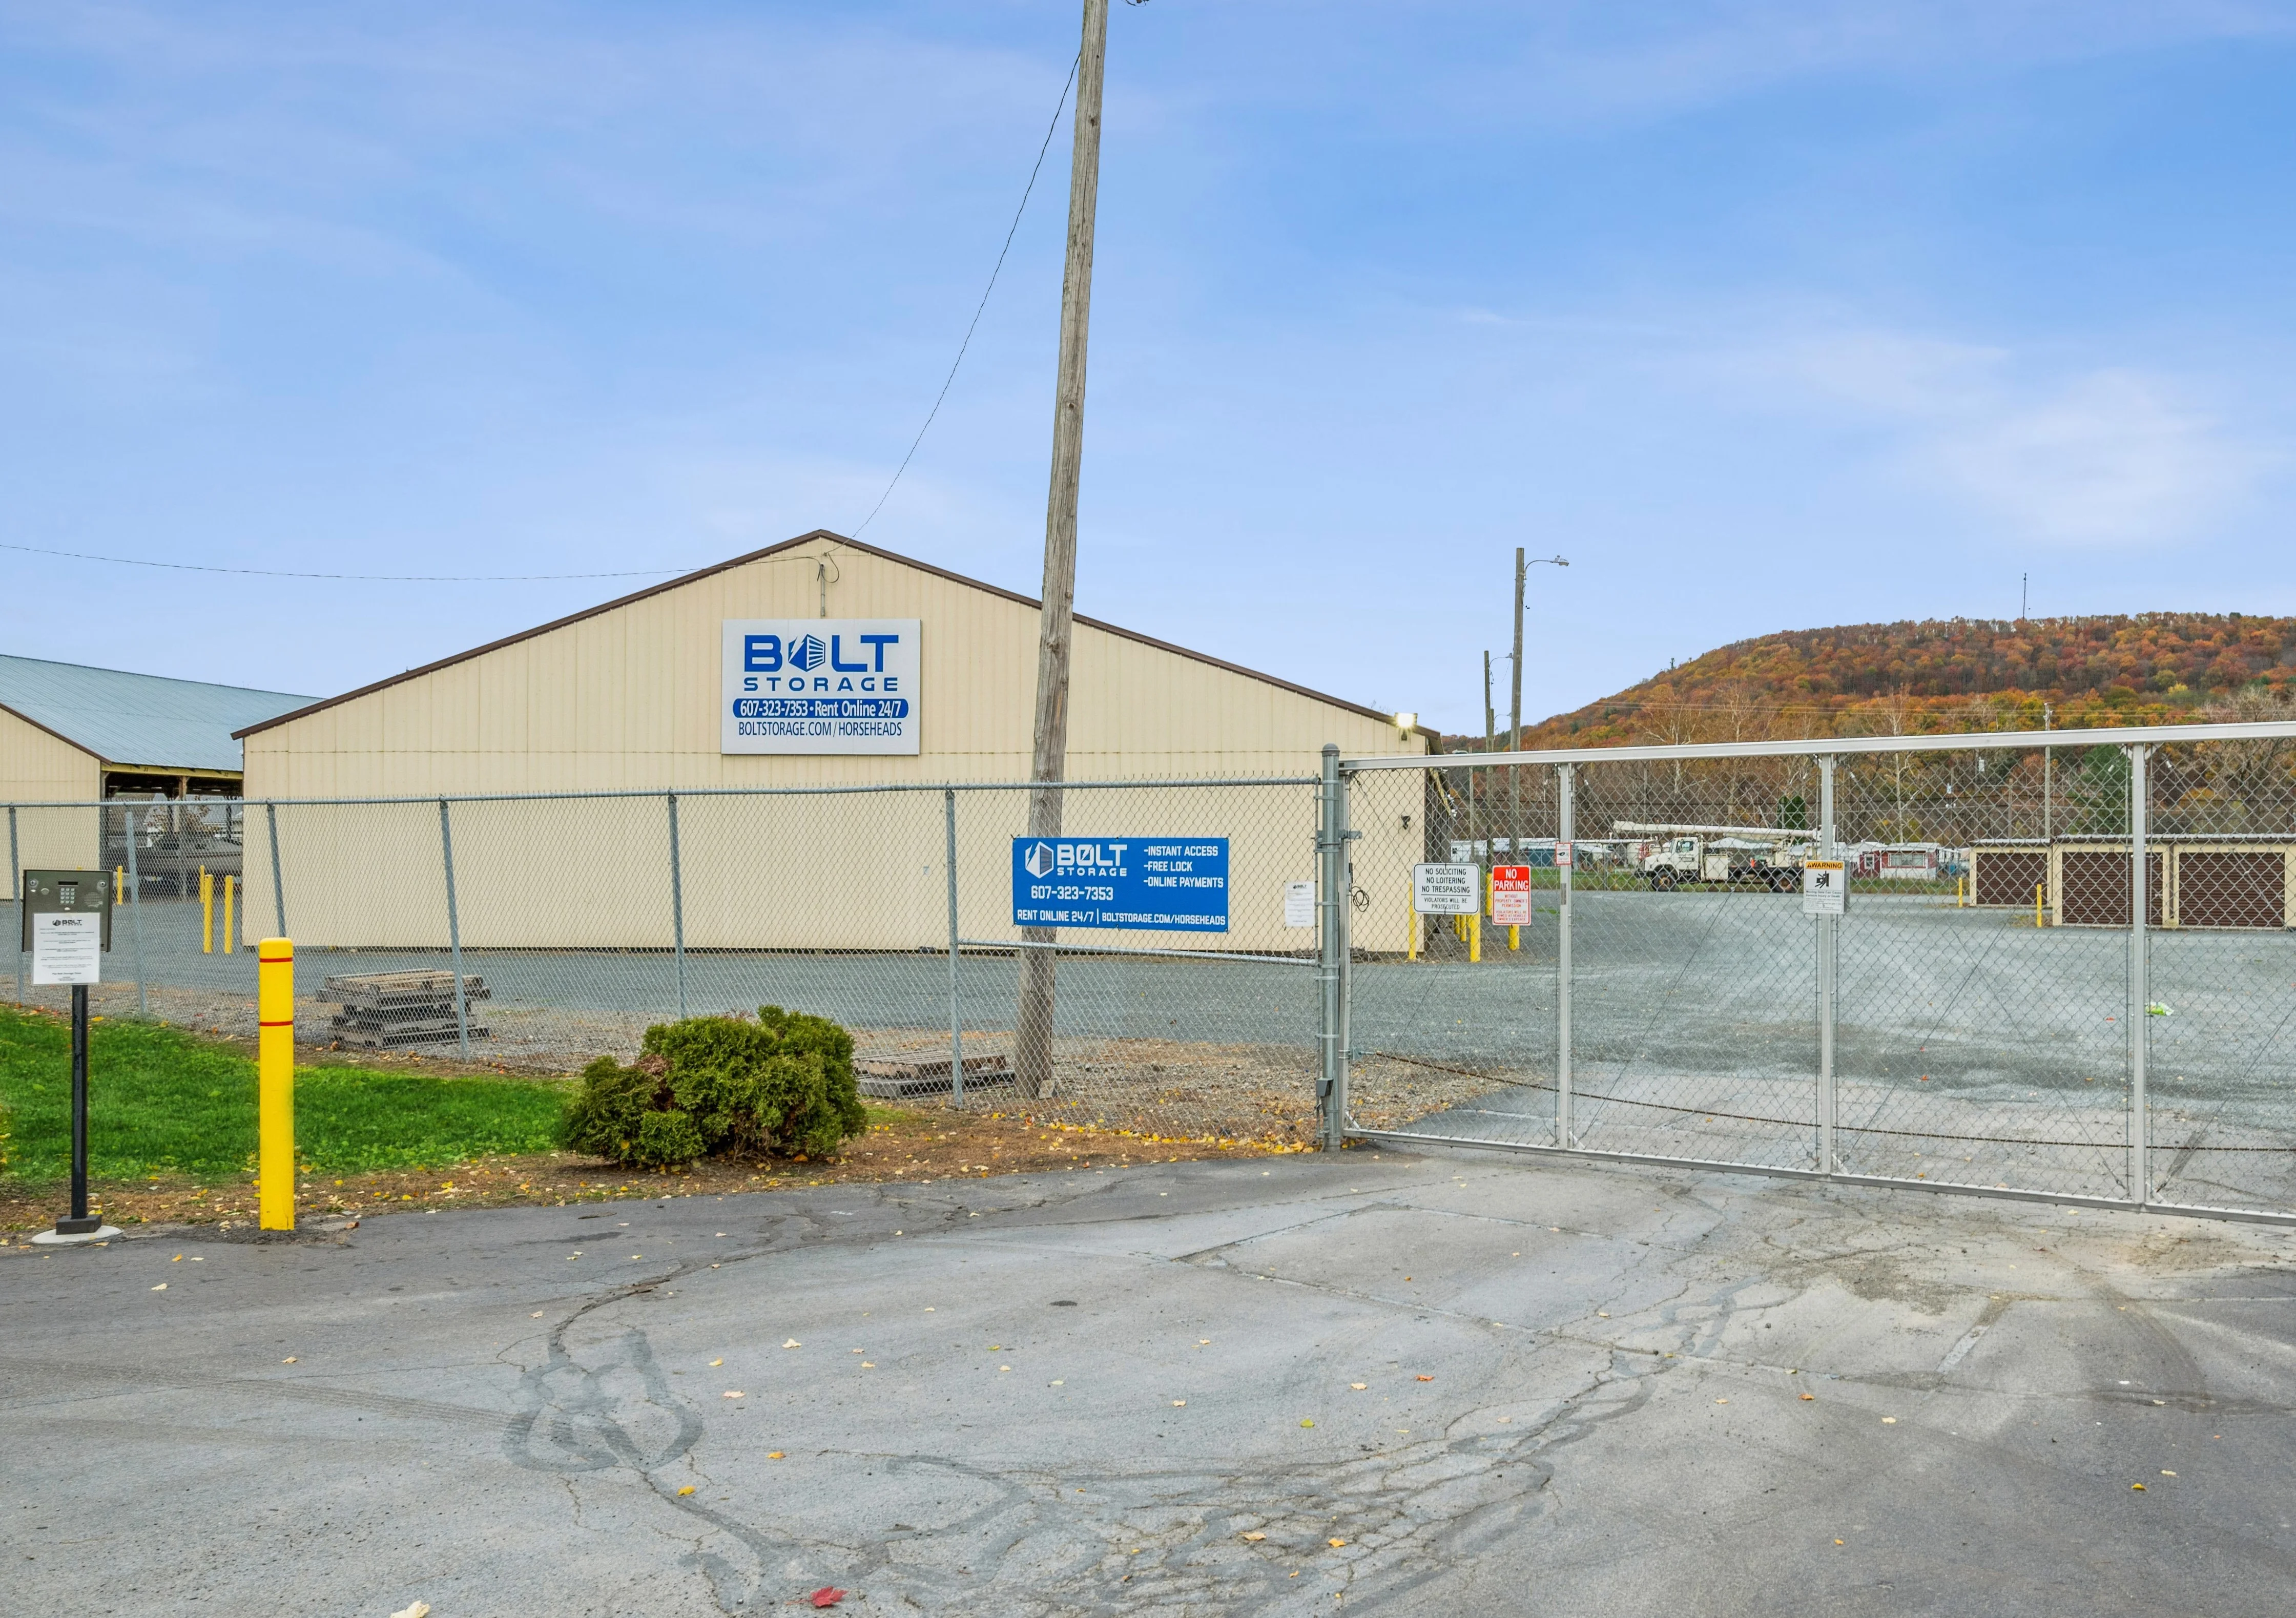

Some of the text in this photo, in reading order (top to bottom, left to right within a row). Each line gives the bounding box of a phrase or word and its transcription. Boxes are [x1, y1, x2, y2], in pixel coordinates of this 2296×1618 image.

[744, 677, 898, 692] STORAGE
[740, 700, 901, 718] 607-323-7353 Rent Online 24/7
[1057, 844, 1127, 866] BOLT
[1184, 846, 1218, 857] ACCESS
[1057, 867, 1127, 877] STORAGE
[1170, 861, 1193, 872] LOCK
[1505, 869, 1517, 879] NO
[1180, 877, 1224, 888] PAYMENTS
[1494, 880, 1529, 890] PARKING
[1031, 885, 1113, 901] 607-323-7353
[1017, 909, 1094, 922] RENT ONLINE 24/7
[1102, 912, 1226, 925] BOLTSTORAGE.COM/HORSEHEADS
